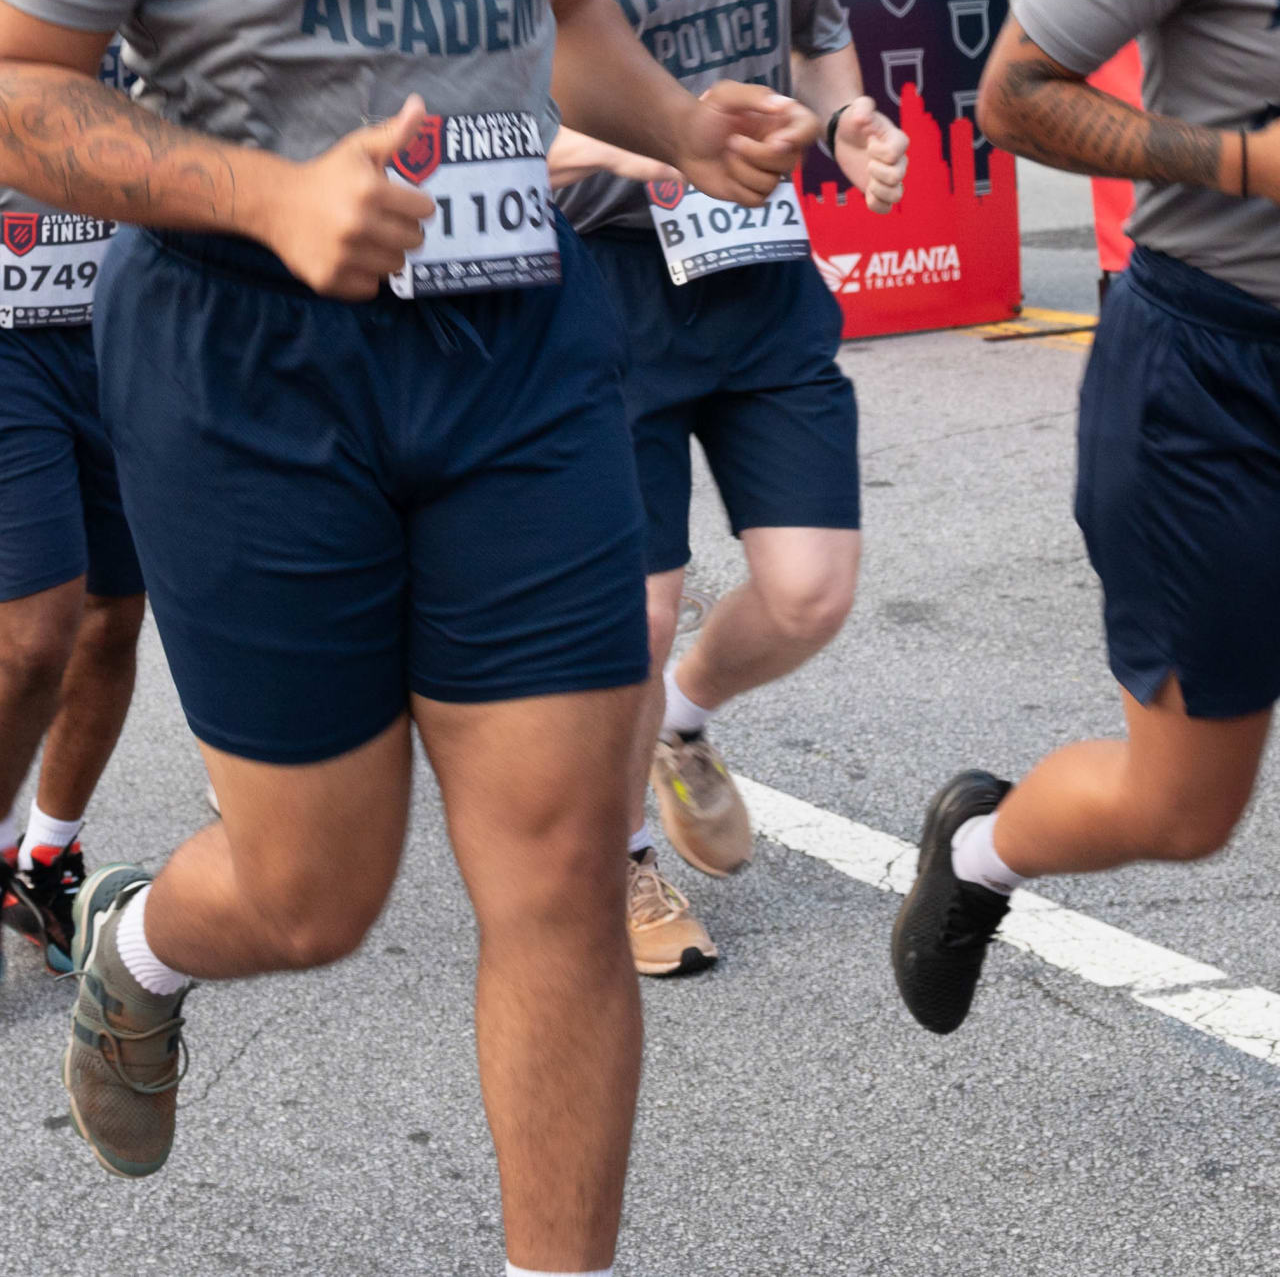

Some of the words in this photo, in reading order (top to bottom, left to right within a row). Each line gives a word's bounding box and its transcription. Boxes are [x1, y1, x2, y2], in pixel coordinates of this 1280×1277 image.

[652, 3, 770, 69] POLICE
[446, 125, 524, 162] FINEST
[420, 185, 556, 238] 1103
[659, 199, 800, 249] B10272
[41, 220, 105, 244] FINEST
[3, 260, 98, 292] D749
[864, 244, 961, 277] ATLANTA
[865, 273, 916, 291] TRACK
[922, 269, 961, 285] CLUB
